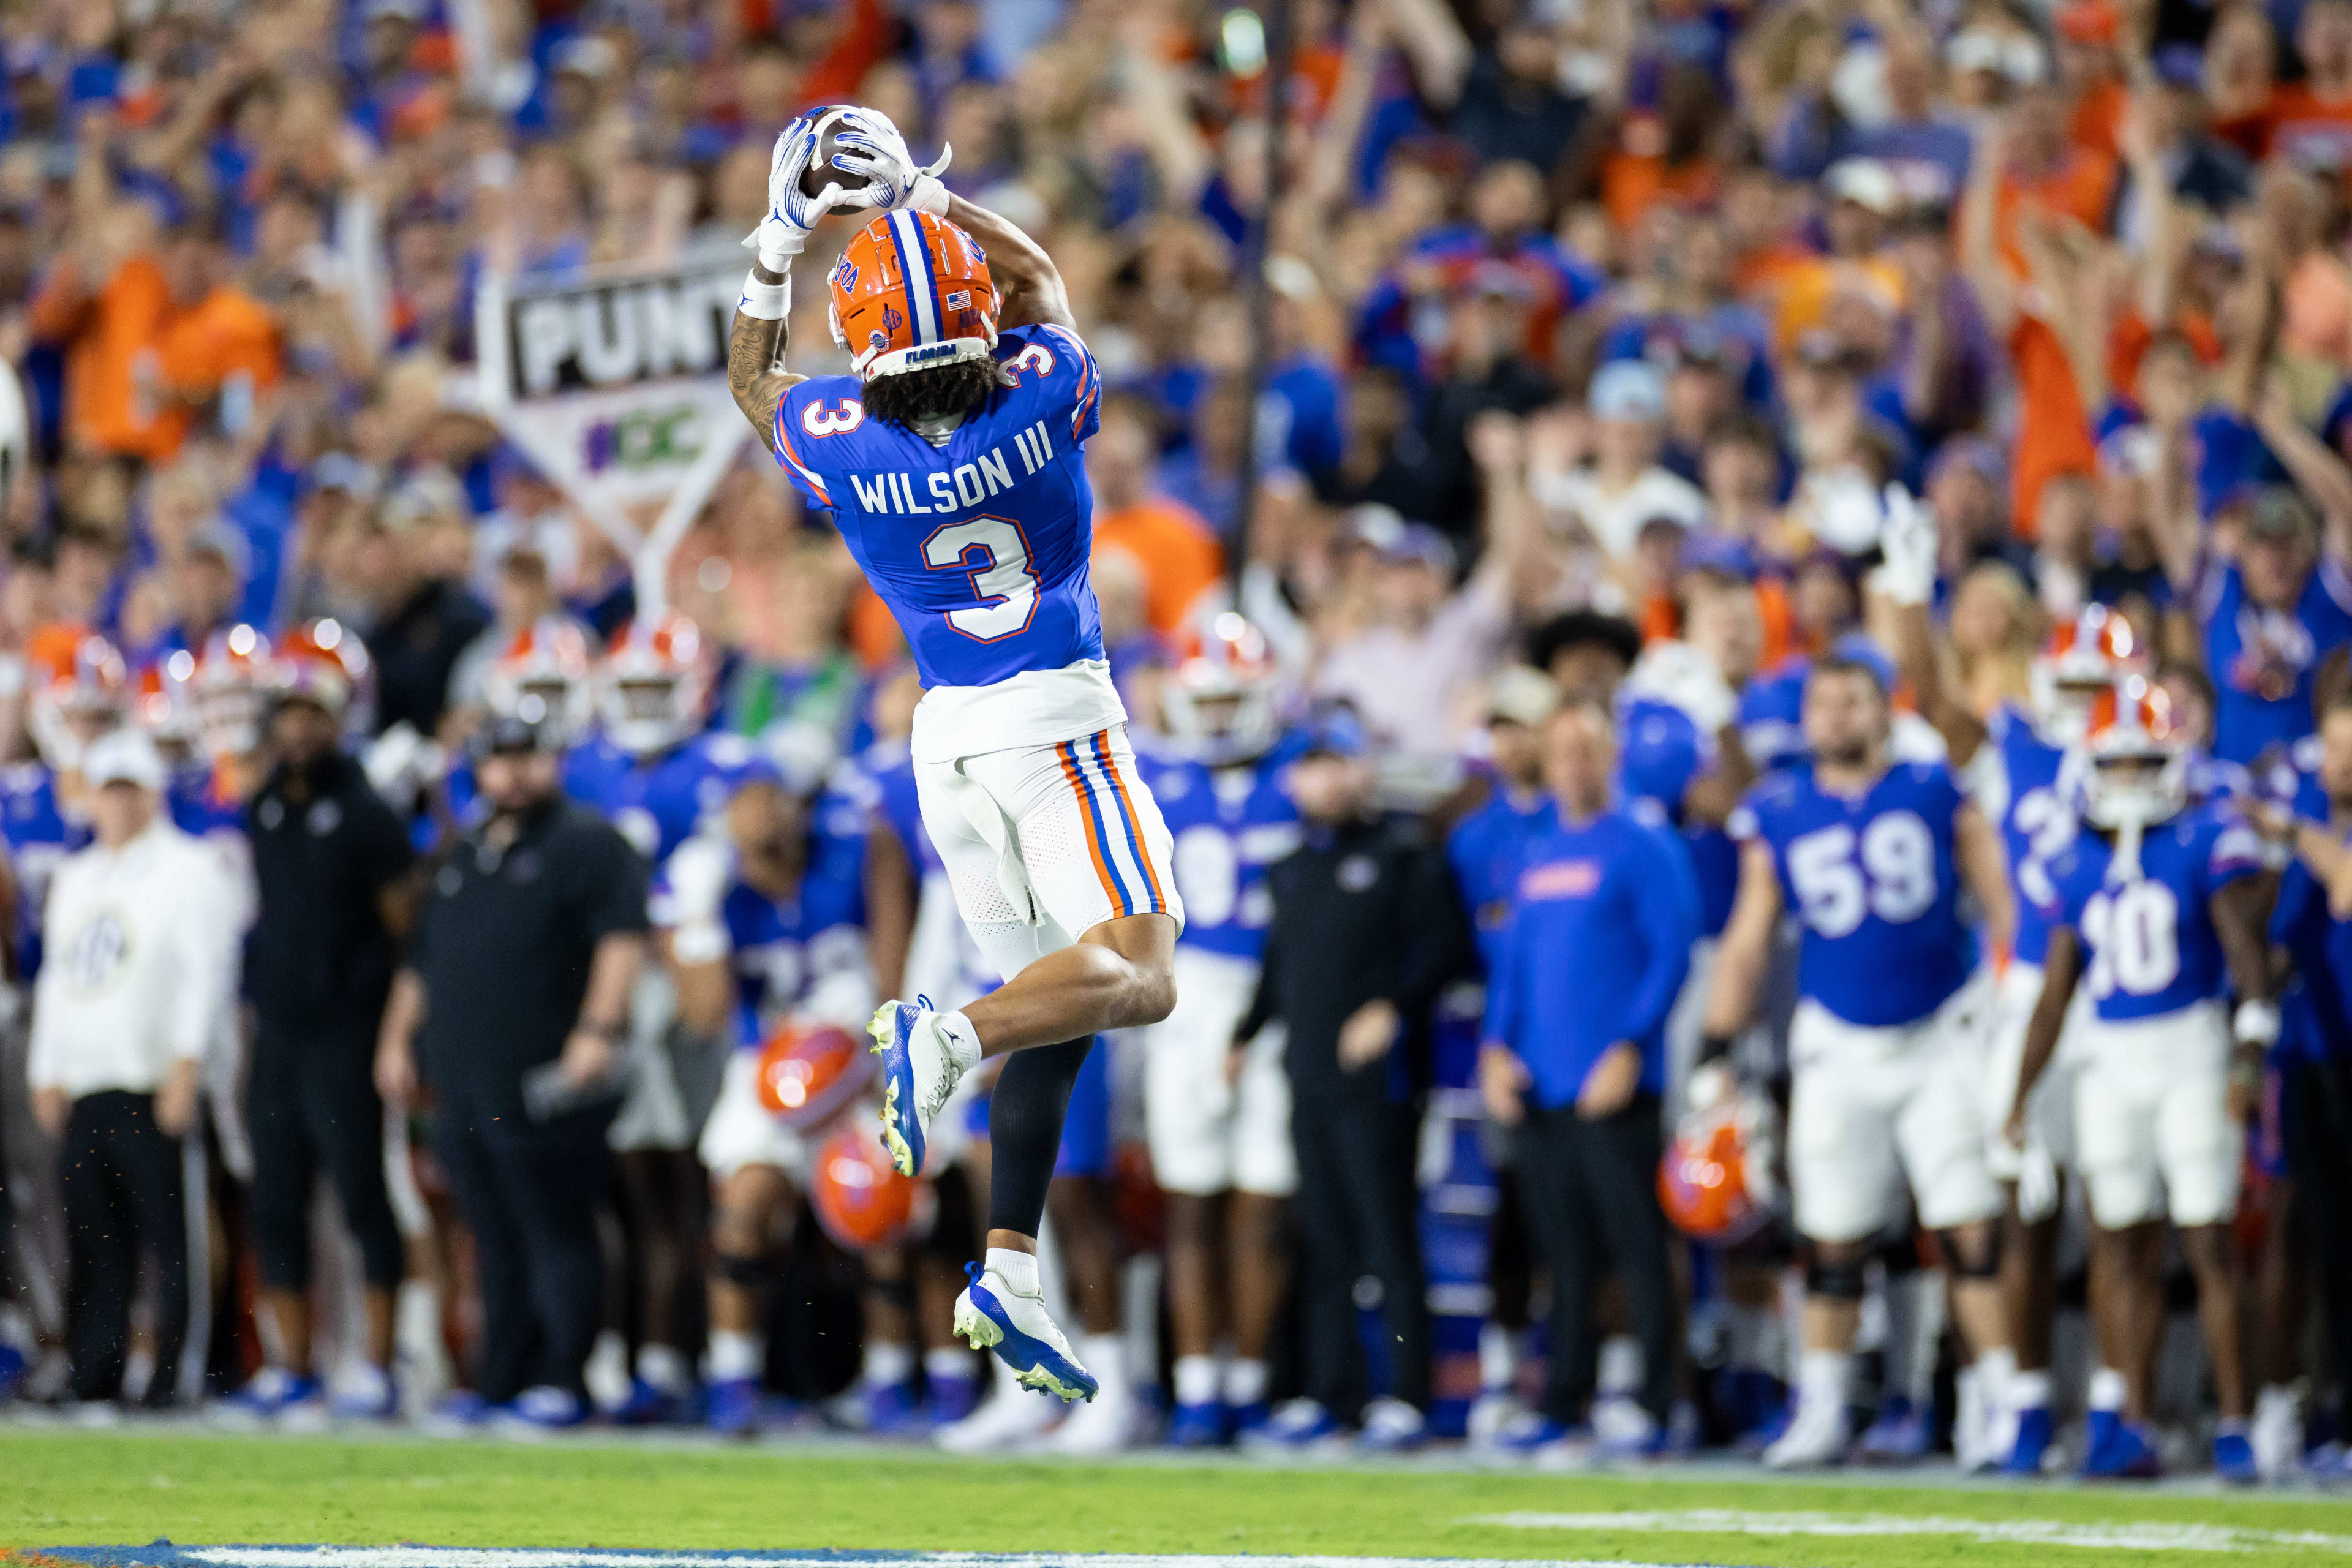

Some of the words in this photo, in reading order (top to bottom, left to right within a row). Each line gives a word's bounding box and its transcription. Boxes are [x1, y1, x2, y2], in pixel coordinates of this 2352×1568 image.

[883, 310, 902, 329] SEC
[905, 344, 957, 364] FLORIDA
[997, 342, 1057, 390] 3
[801, 397, 865, 439] 3
[850, 447, 1014, 514] WILSON
[1014, 420, 1054, 476] III
[920, 514, 1042, 644] 3
[1785, 809, 1939, 939] 59
